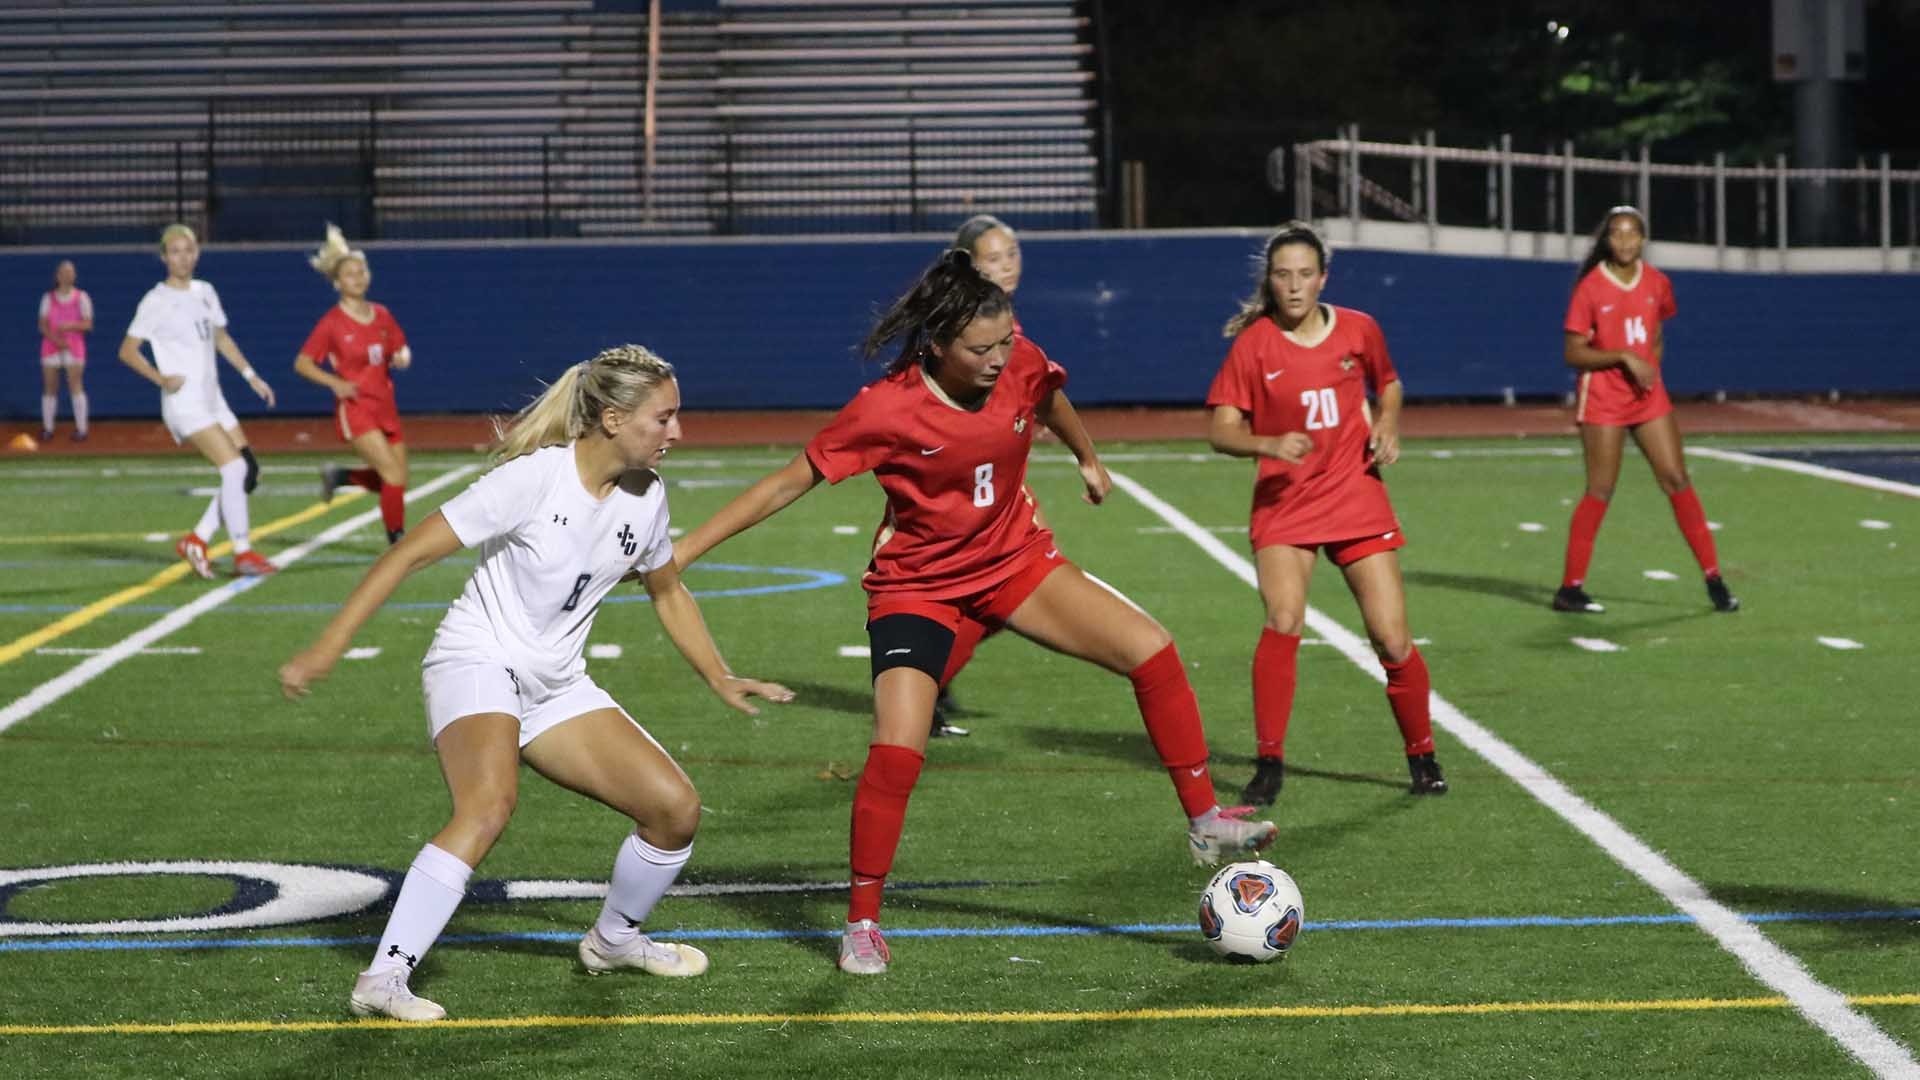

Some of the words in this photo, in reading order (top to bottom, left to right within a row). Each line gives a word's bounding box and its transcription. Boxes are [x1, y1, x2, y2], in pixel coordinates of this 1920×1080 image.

[1625, 315, 1647, 346] 14
[1301, 388, 1340, 430] 20
[973, 463, 994, 508] 8
[561, 573, 592, 612] 8
